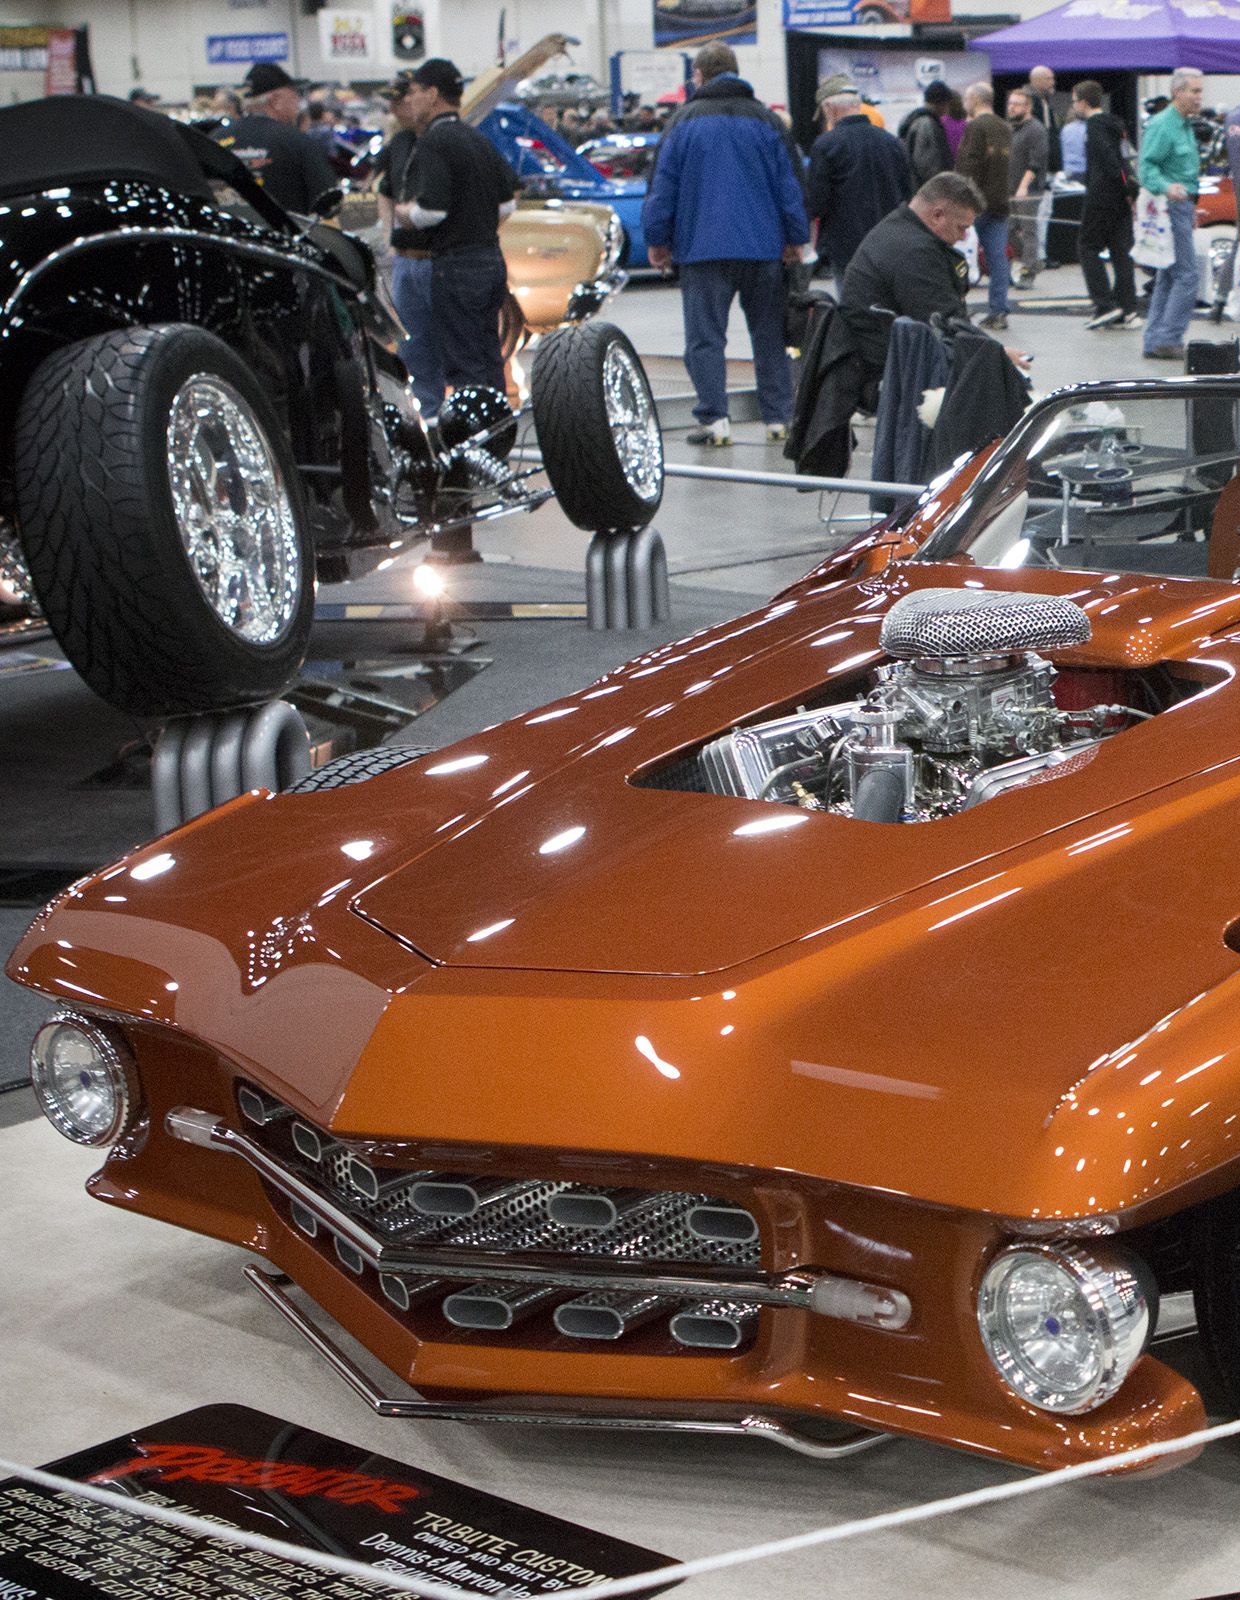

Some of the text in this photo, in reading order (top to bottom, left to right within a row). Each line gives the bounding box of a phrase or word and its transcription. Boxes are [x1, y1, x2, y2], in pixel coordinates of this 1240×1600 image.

[2, 1505, 57, 1530] ROTH,
[48, 1525, 101, 1544] DAVE
[91, 1542, 173, 1577] STUCKEY,
[161, 1572, 222, 1597] DARYL
[3, 1488, 65, 1512] BARRIS
[93, 1525, 132, 1539] JOE
[176, 1560, 222, 1578] BILL
[6, 1523, 51, 1541] YOU
[39, 1539, 94, 1560] LOOK
[86, 1557, 133, 1577] THIS
[135, 1490, 176, 1507] THIS
[341, 1574, 398, 1594] BUILT
[206, 1537, 247, 1553] CAR
[239, 1550, 326, 1584] BUILDERS
[359, 1532, 432, 1564] Dennis
[433, 1560, 507, 1593] Marion
[413, 1511, 614, 1588] TRIBUTE CUSTOM
[413, 1531, 573, 1591] OWNED AND BUILT BY
[24, 1551, 97, 1581] CUSTOM
[194, 1549, 264, 1576] PEOPLE
[256, 1574, 302, 1591] LIKE
